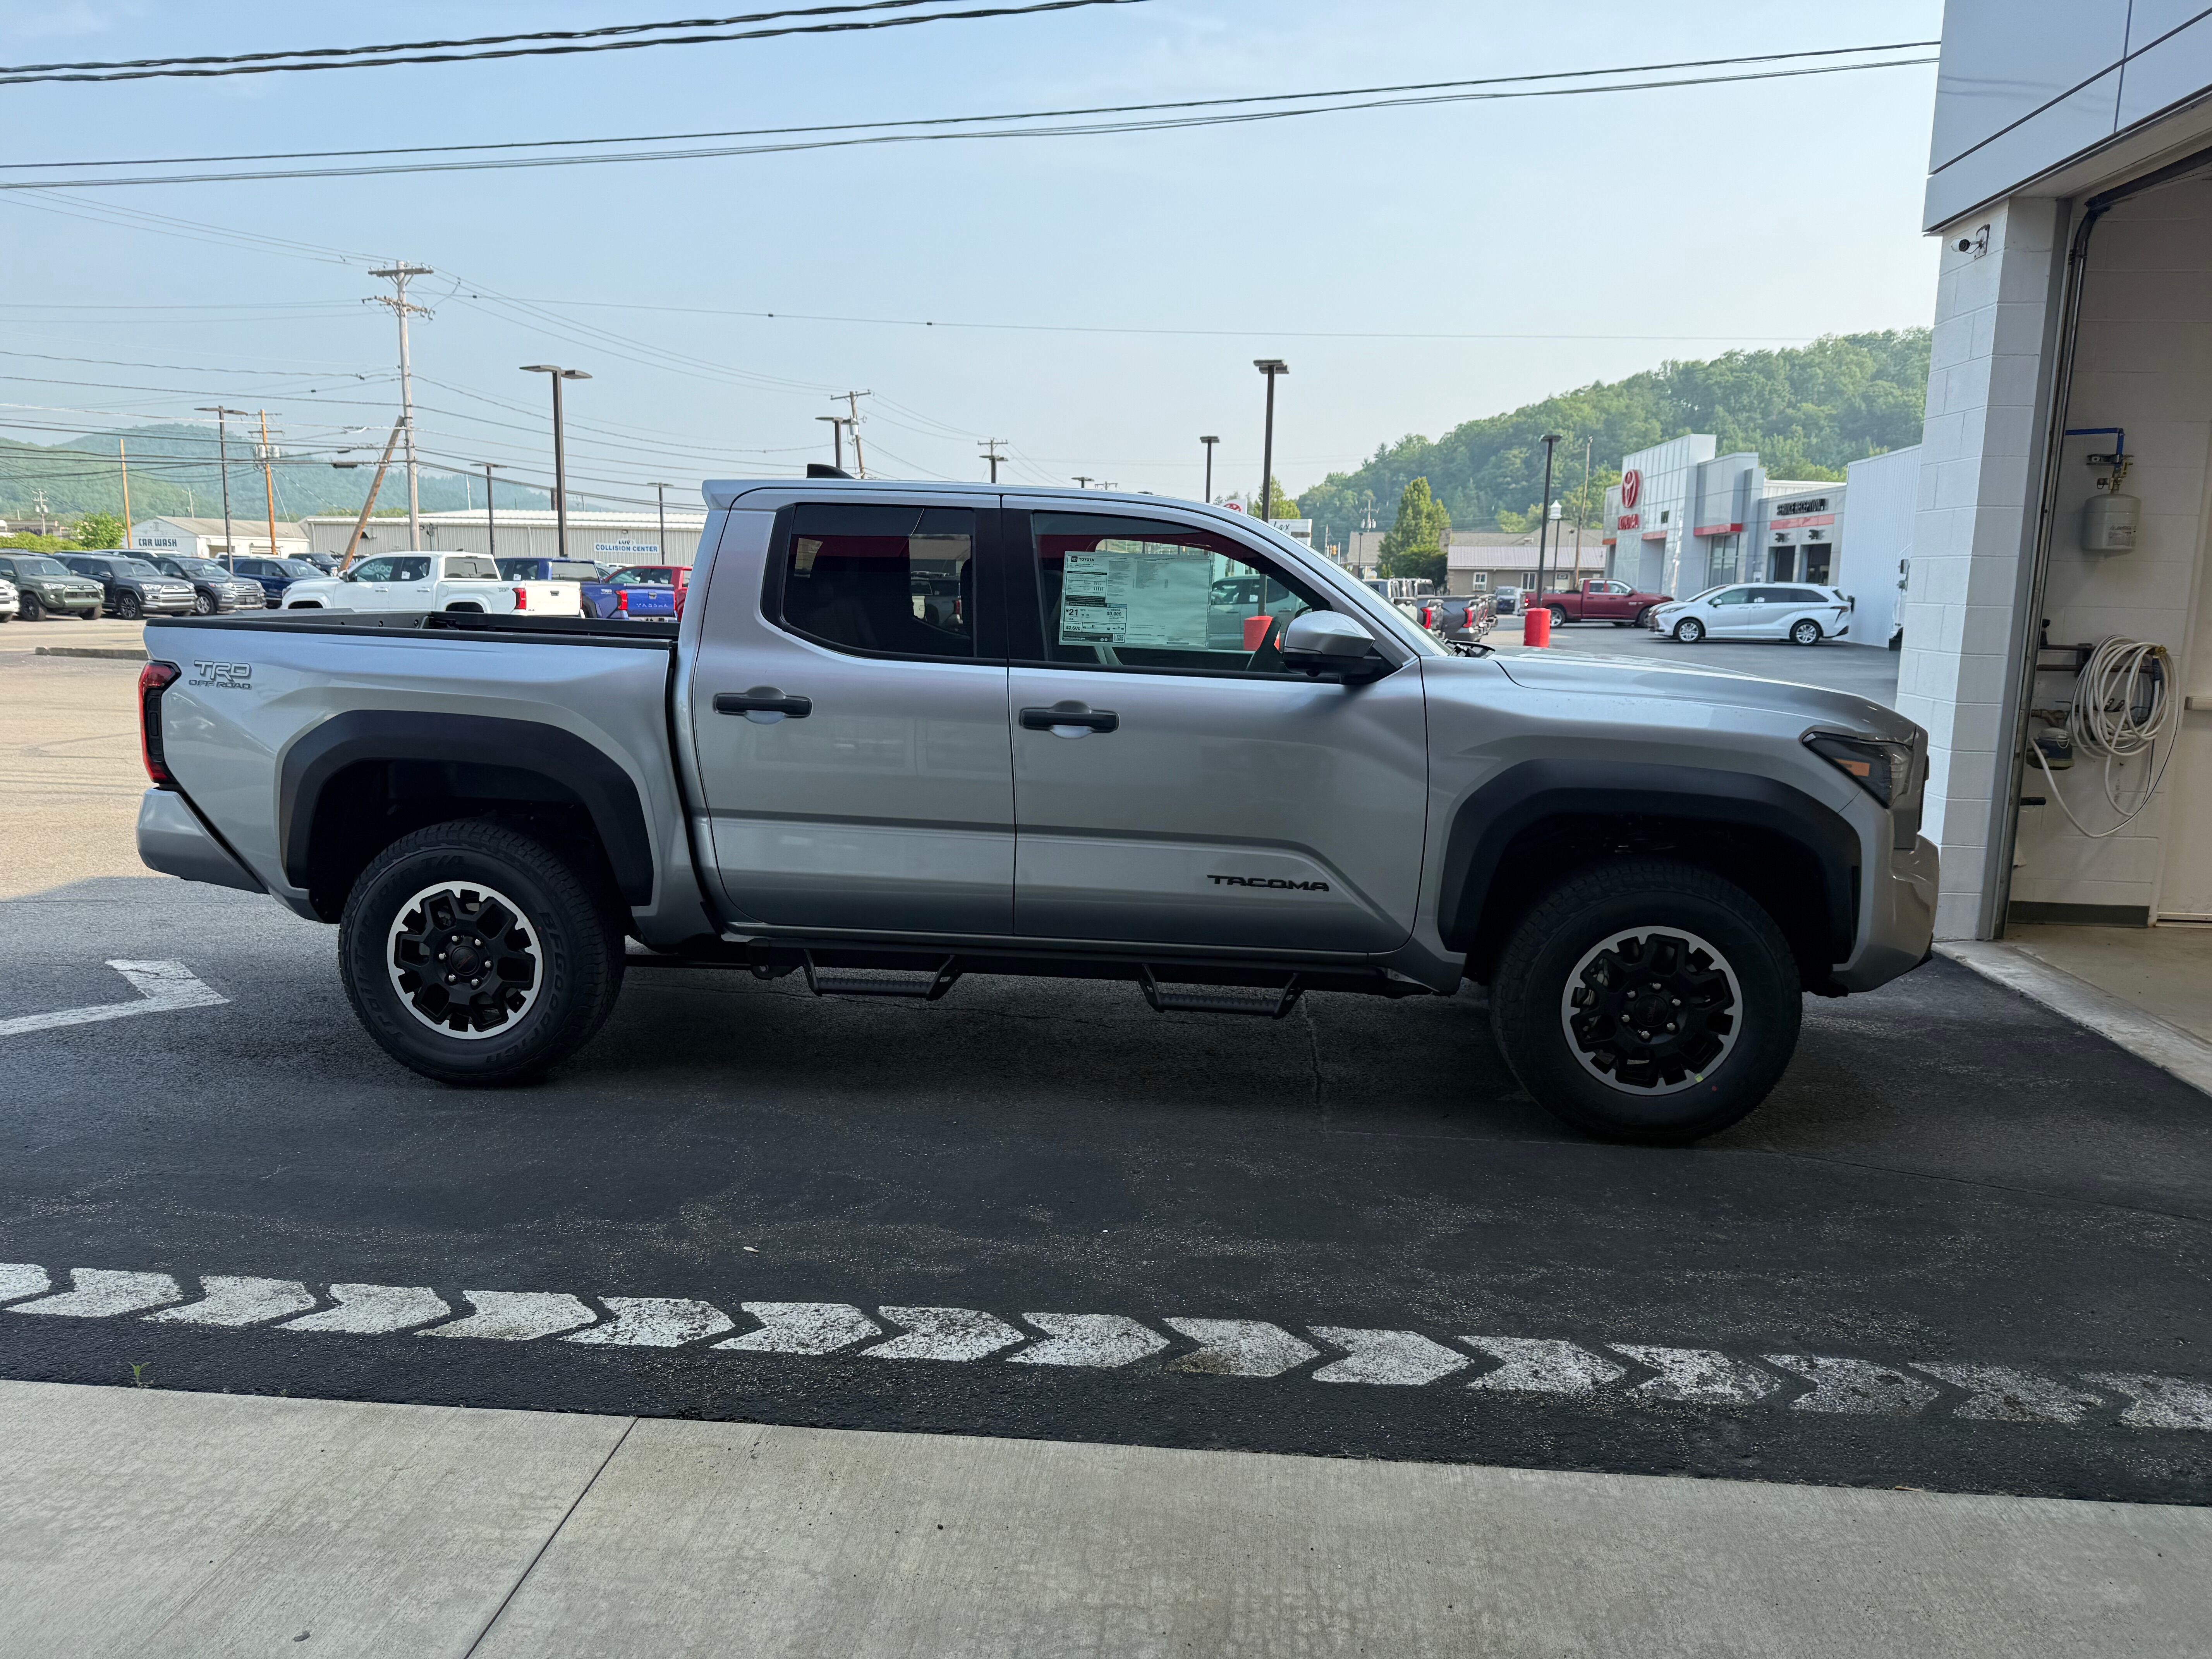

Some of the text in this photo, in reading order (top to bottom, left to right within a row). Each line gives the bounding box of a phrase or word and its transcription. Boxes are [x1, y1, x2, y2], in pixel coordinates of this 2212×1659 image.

[139, 538, 177, 547] CAR WASH
[194, 660, 252, 682] TRD
[189, 679, 252, 690] OFF ROAD
[1206, 874, 1329, 891] TACOMA
